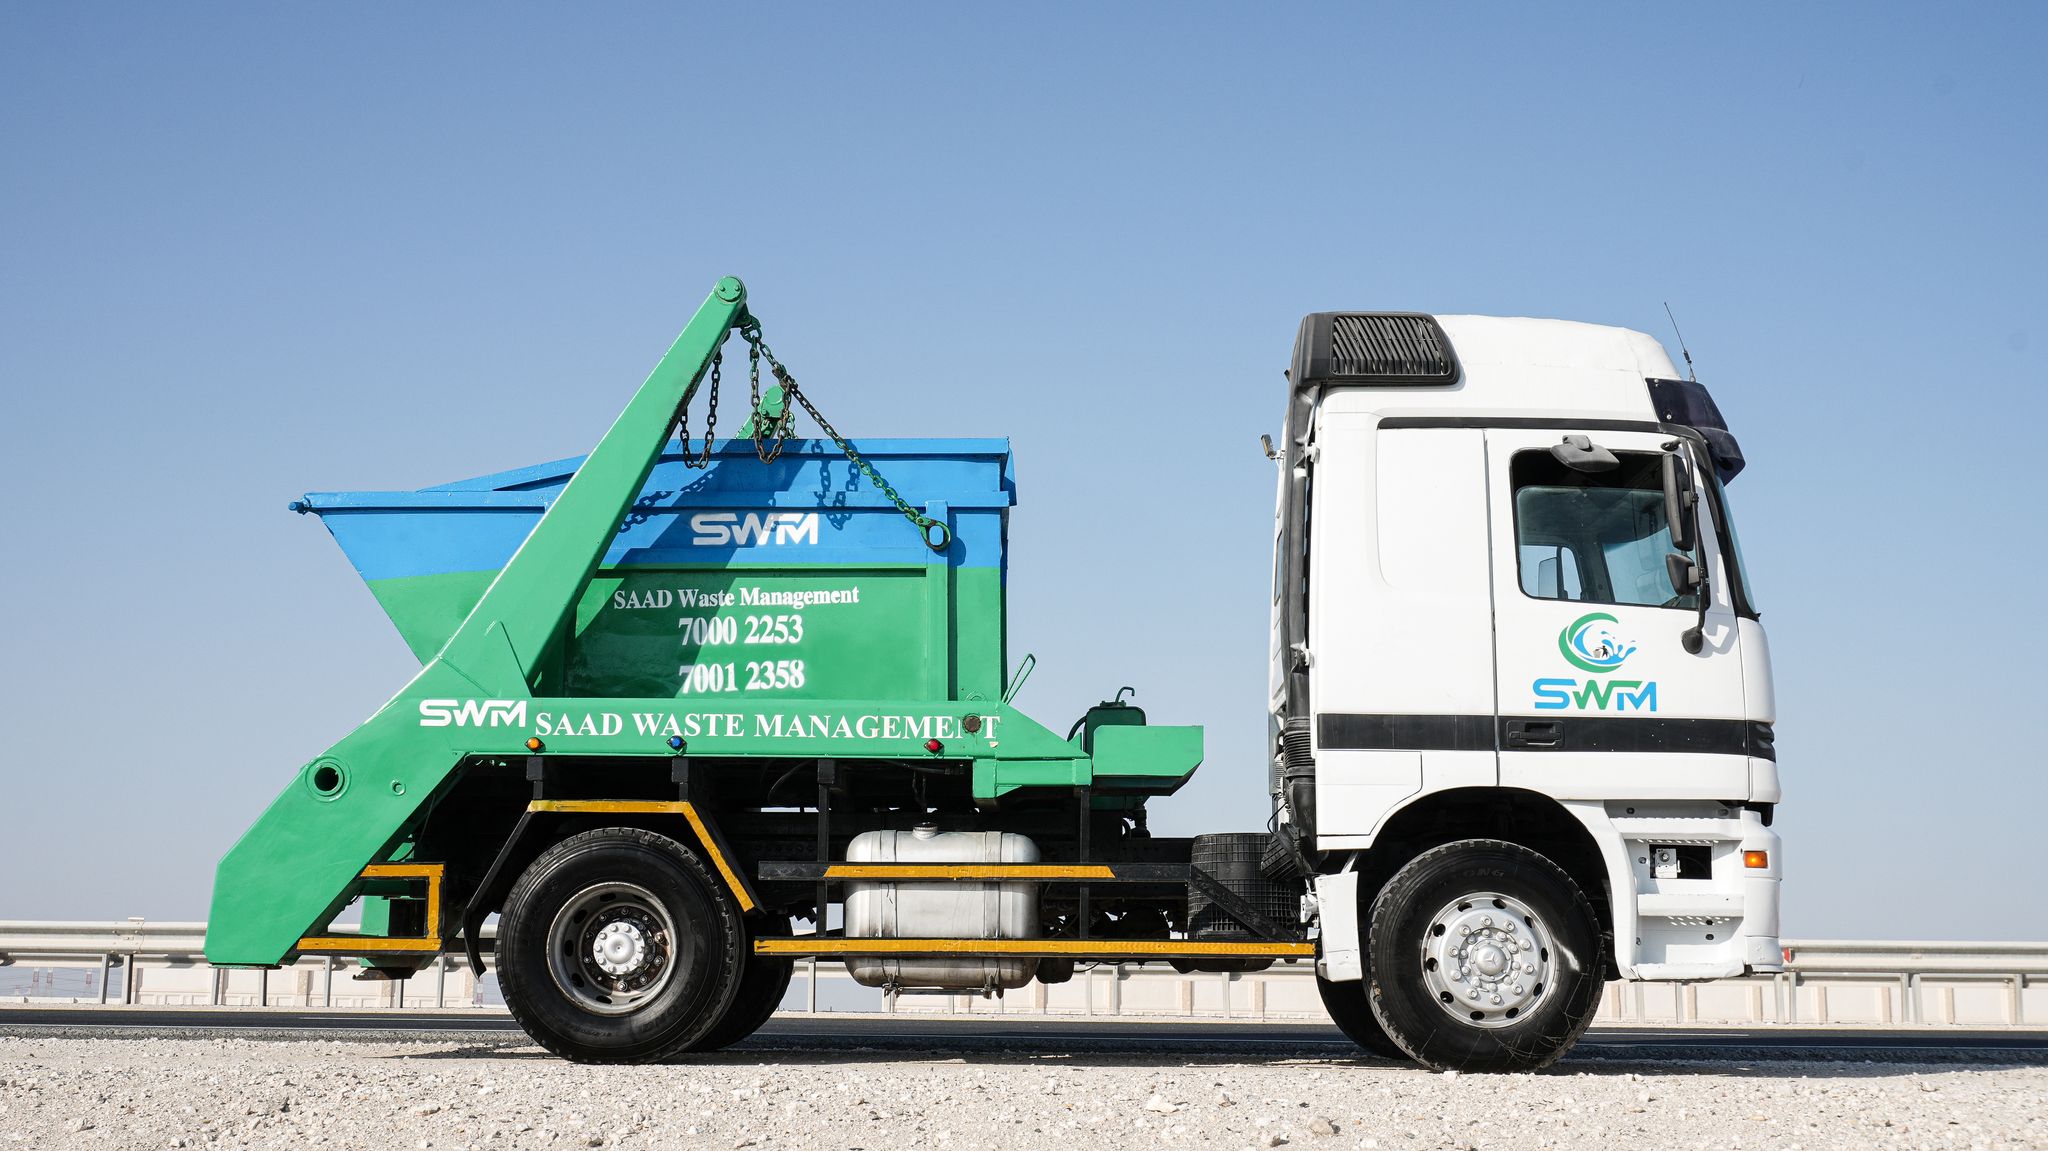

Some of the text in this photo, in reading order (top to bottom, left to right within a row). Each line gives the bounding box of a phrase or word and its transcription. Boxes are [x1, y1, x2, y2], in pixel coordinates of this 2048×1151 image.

[692, 513, 818, 545] SWM
[613, 586, 860, 609] SAAD Waste Management
[678, 615, 803, 646] 7000 2253
[678, 660, 805, 694] 7001 2358
[1533, 678, 1657, 711] SWM
[419, 699, 527, 727] SWM
[535, 713, 1000, 739] SAAD WASTE MANAGEMET
